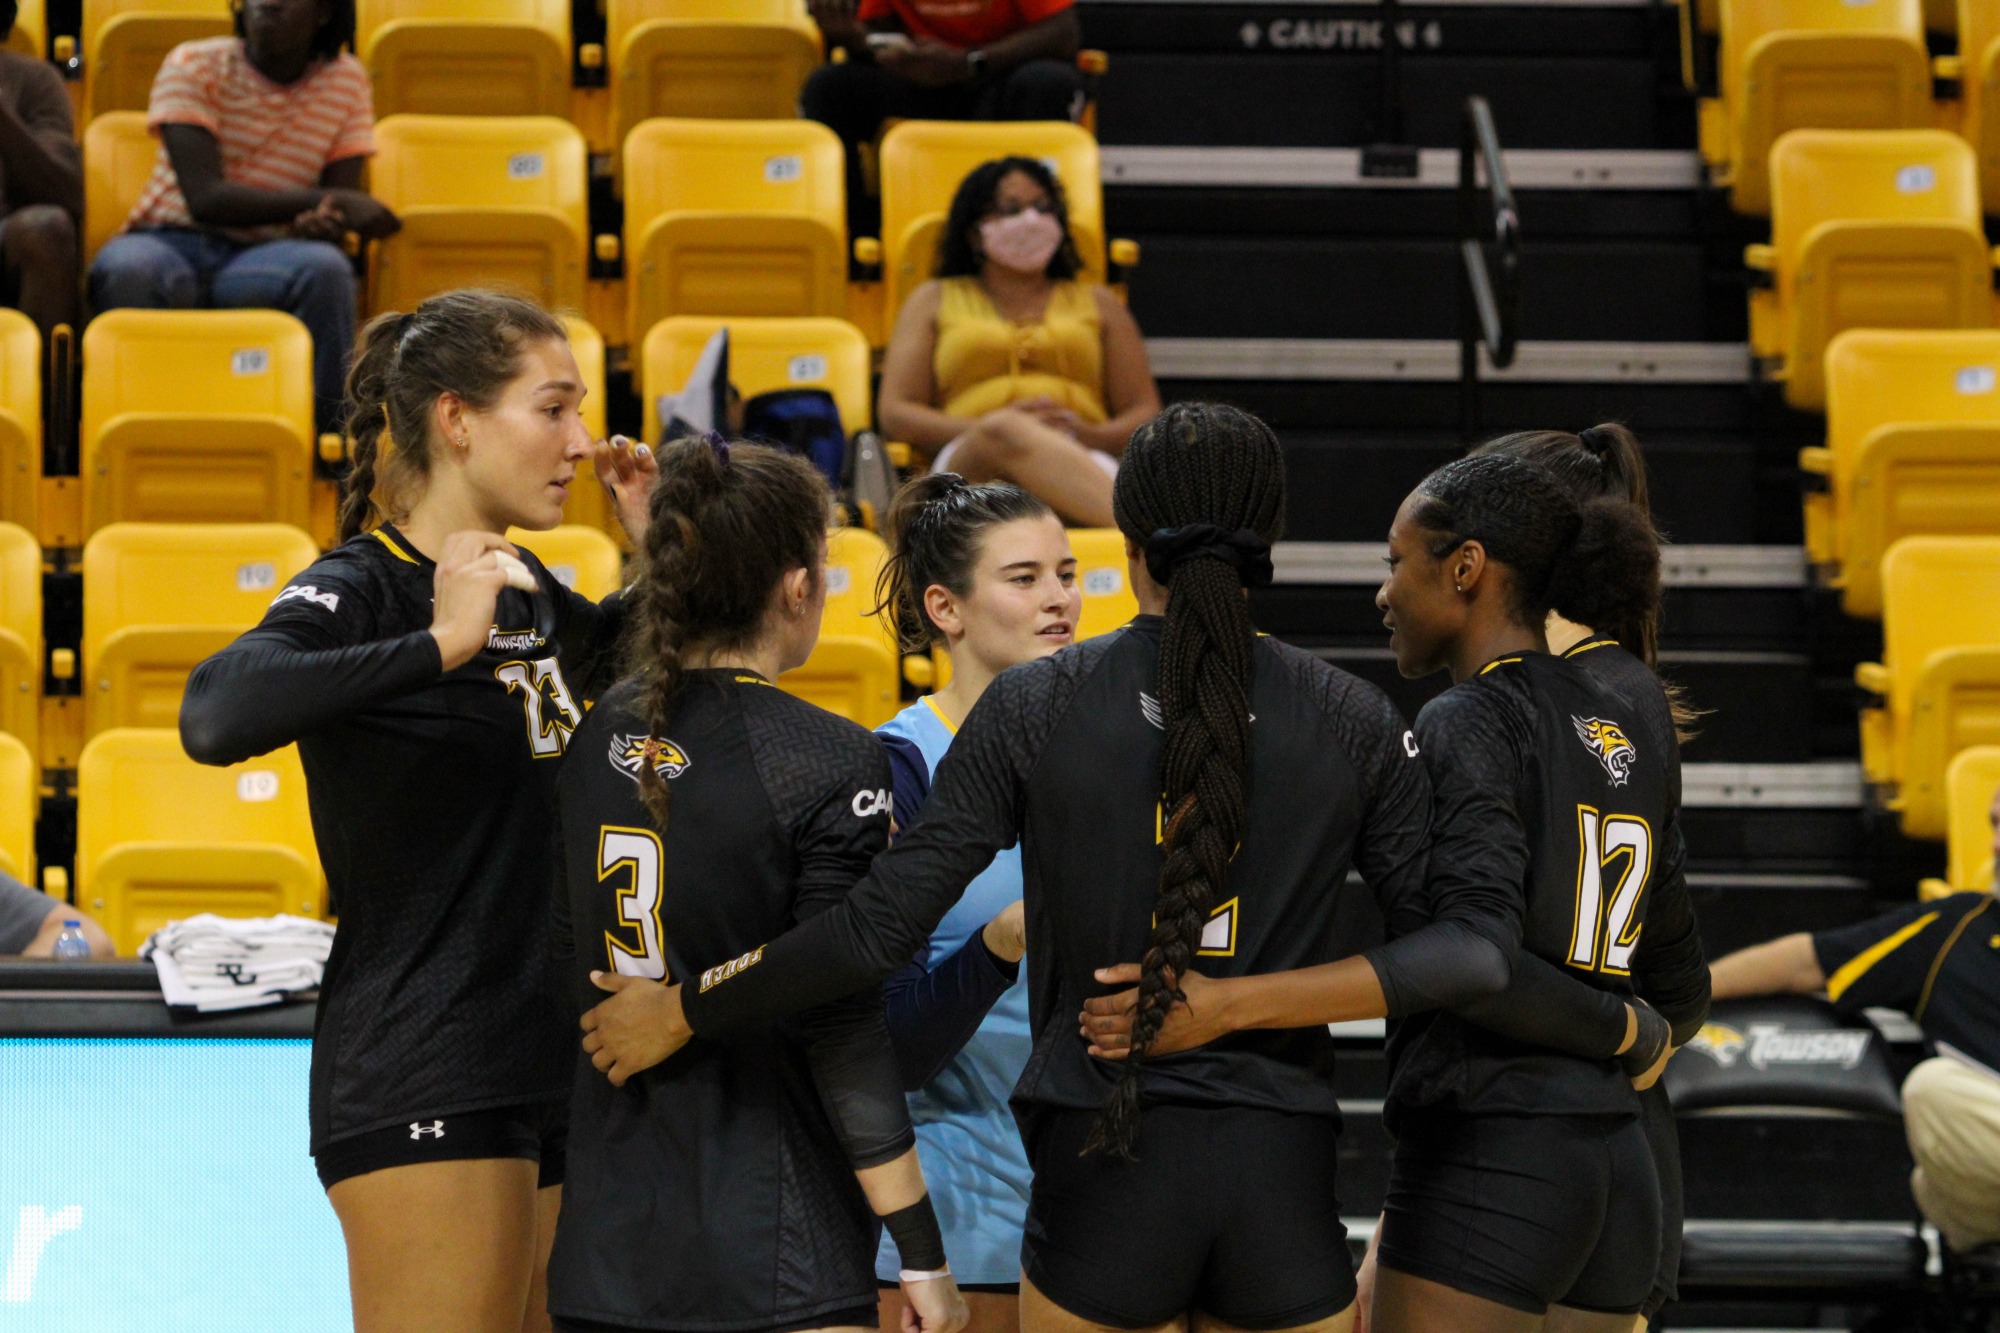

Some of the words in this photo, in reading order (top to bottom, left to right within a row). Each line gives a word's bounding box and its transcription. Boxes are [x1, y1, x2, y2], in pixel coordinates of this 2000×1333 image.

[269, 585, 340, 613] CAA
[495, 657, 582, 759] 23
[598, 825, 670, 985] 3
[1565, 803, 1653, 976] 12
